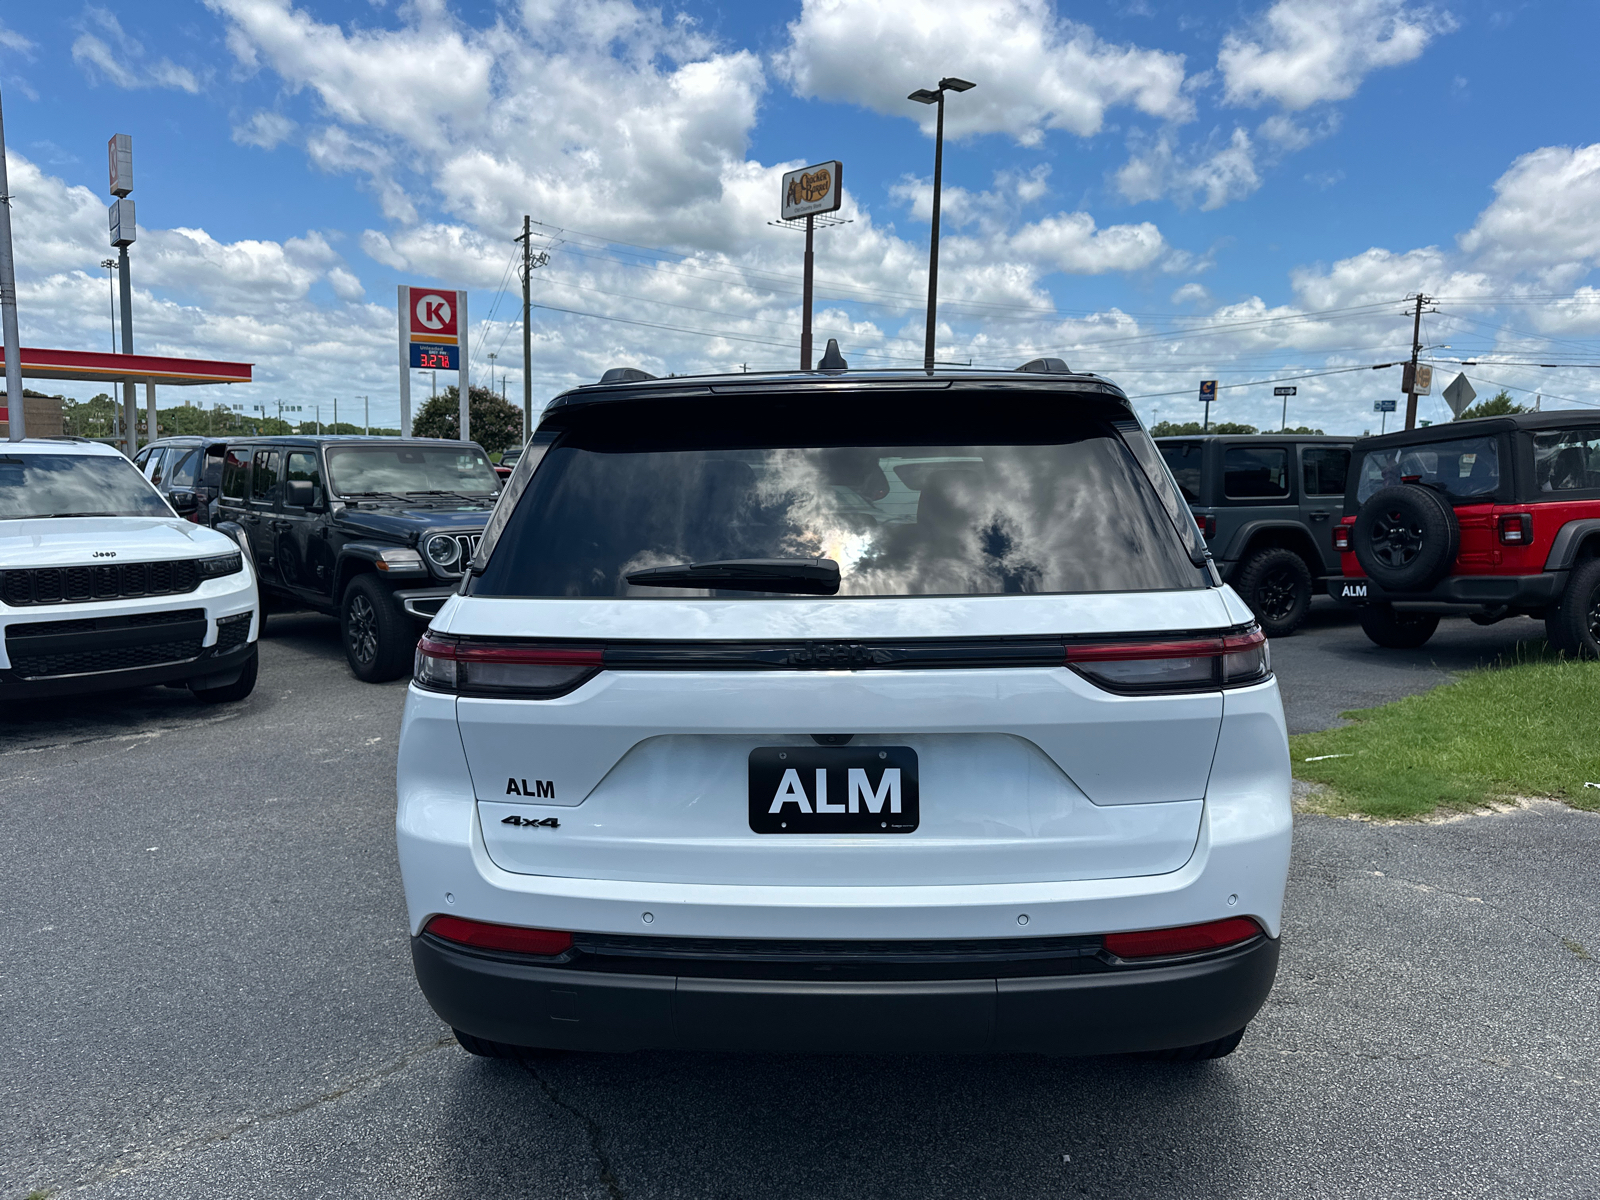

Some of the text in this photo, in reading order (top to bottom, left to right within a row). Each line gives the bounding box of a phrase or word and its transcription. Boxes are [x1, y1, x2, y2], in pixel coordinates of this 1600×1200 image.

[801, 175, 827, 190] Cracker
[806, 181, 828, 201] Barrel
[426, 302, 448, 327] K
[1342, 585, 1367, 597] ALM
[790, 641, 868, 665] Jeep
[506, 777, 555, 799] ALM
[768, 767, 902, 814] ALM
[501, 815, 561, 828] 4x4
